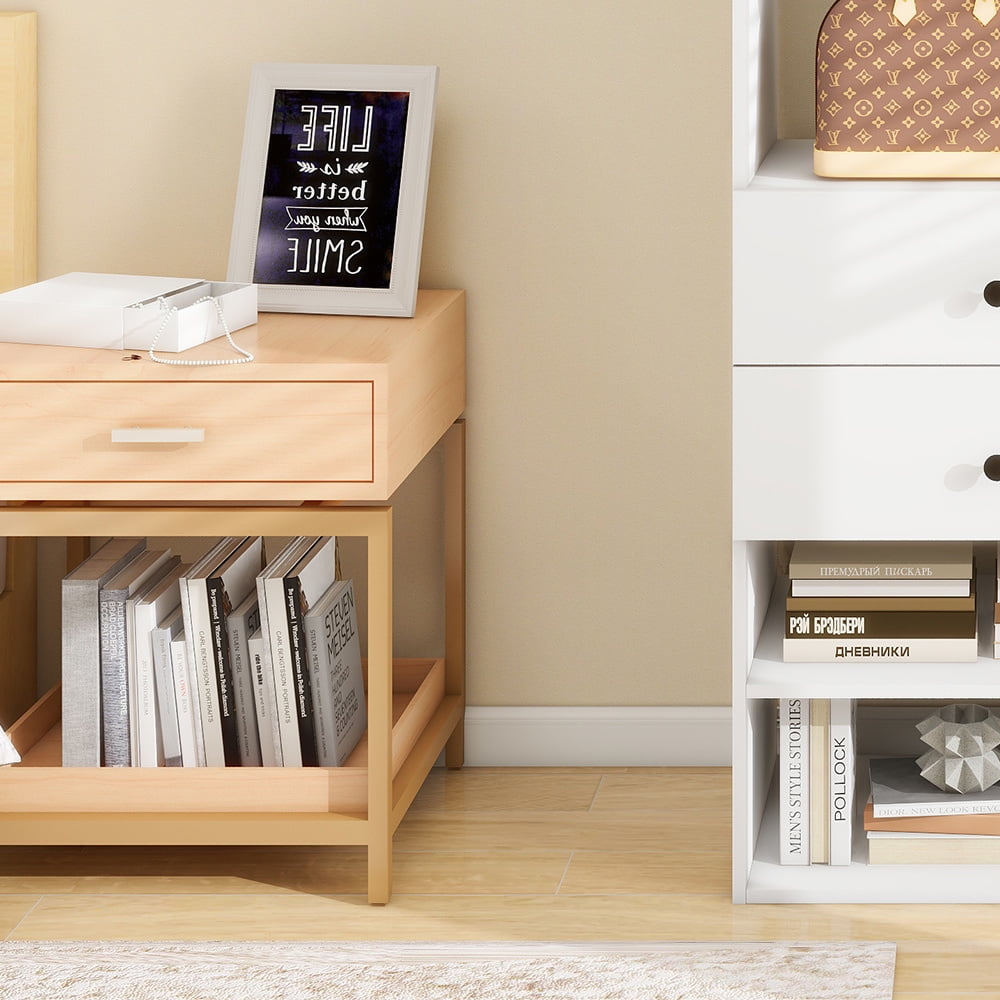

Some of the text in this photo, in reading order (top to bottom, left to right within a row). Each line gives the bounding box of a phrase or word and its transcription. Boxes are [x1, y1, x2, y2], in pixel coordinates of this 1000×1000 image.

[820, 566, 933, 576] ПРЕМУДРЫЙ ПИСКАРЬ
[324, 587, 354, 638] STEVEN
[789, 613, 865, 635] РЭЙ БРЭДБЕРИ
[327, 619, 355, 666] MEISEL
[835, 646, 910, 658] ДНЕВНИКИ
[789, 699, 801, 854] MEN'S STYLE STORIES
[834, 737, 846, 821] POLLOCK
[912, 807, 935, 815] NEW
[940, 806, 968, 814] LOOK
